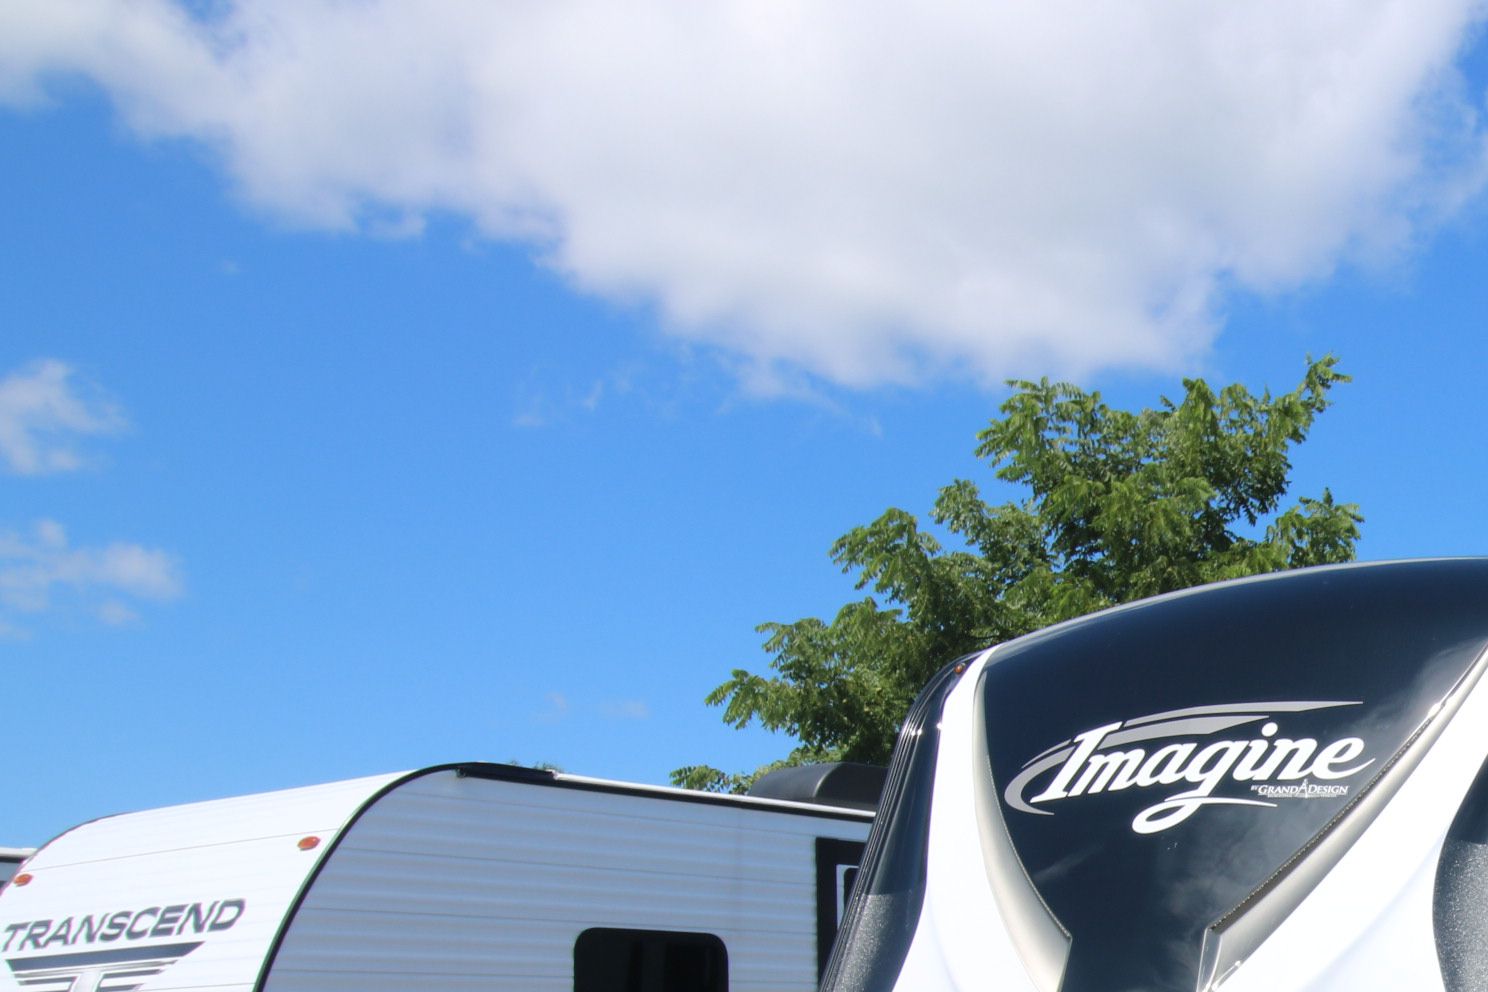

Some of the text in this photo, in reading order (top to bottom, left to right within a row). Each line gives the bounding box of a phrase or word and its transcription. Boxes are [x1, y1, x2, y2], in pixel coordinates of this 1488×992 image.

[1030, 721, 1376, 835] Imagine
[1258, 784, 1299, 795] GRAND
[1308, 784, 1349, 795] DESIGN
[2, 898, 246, 951] TRANSCEND
